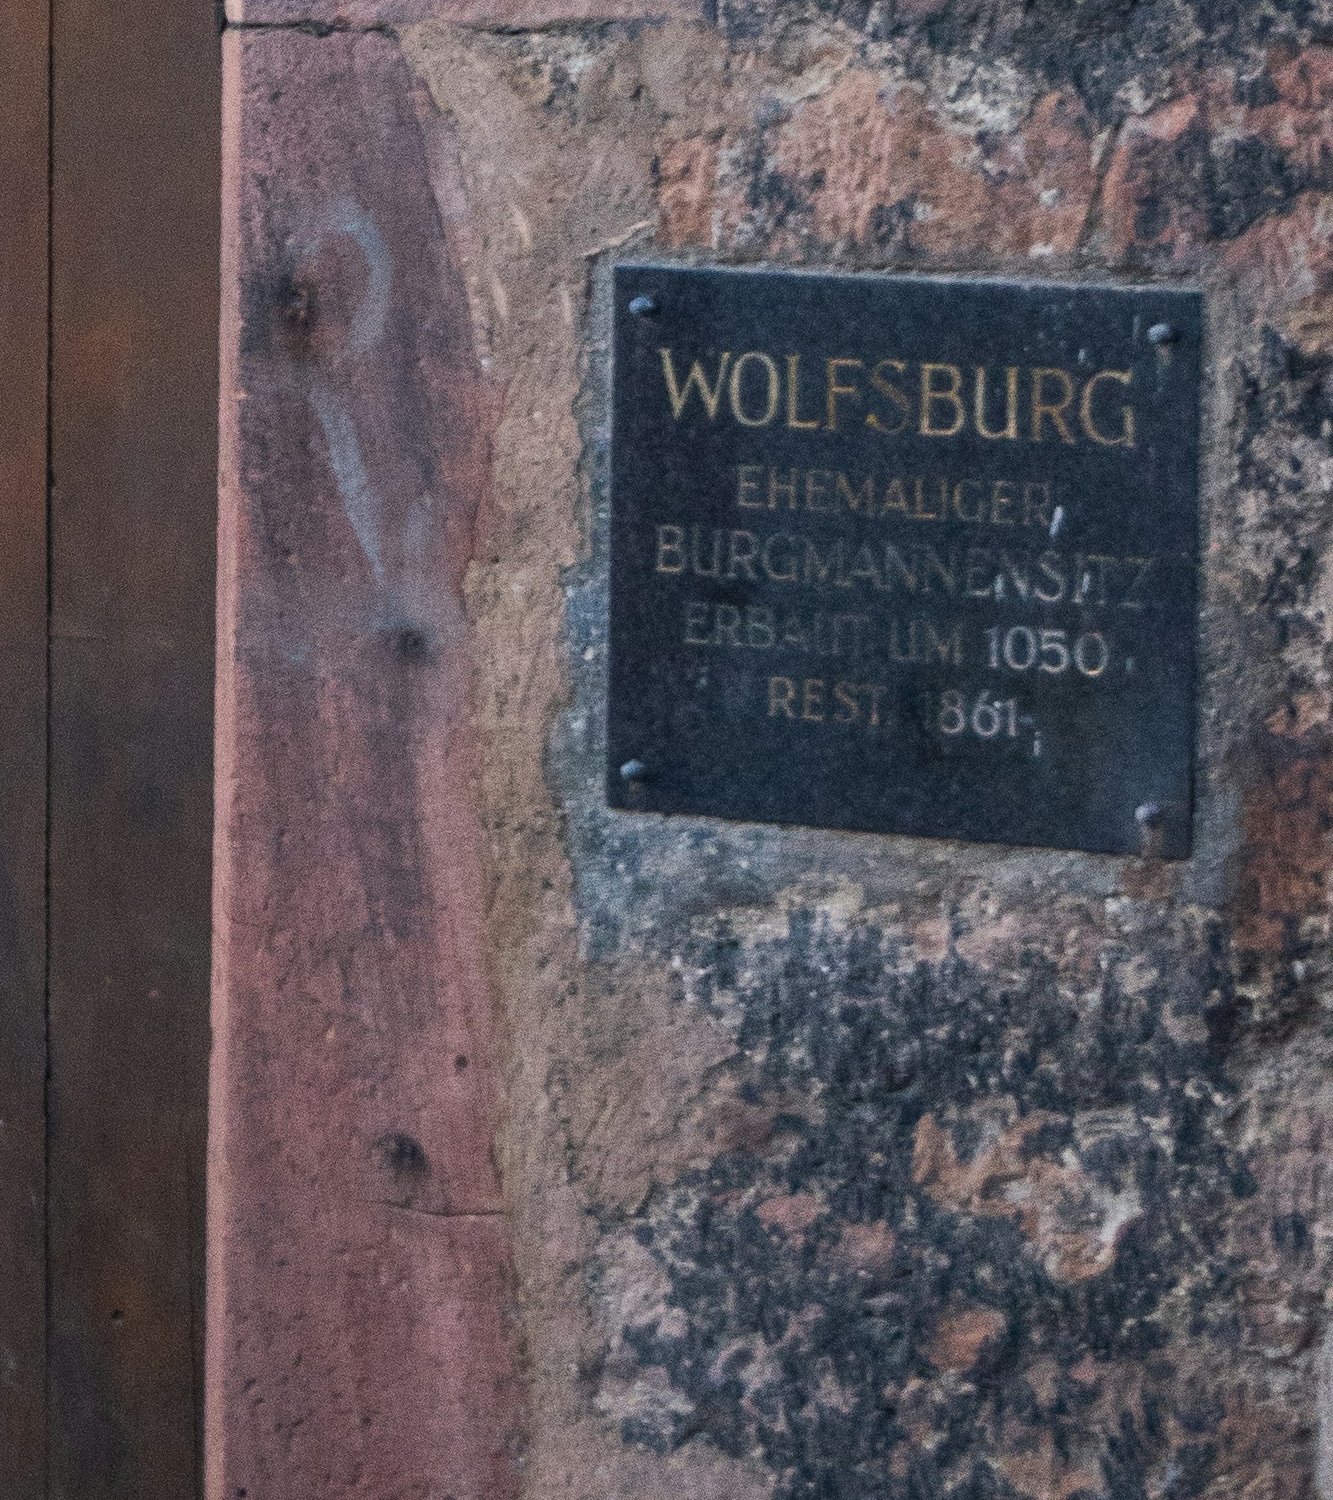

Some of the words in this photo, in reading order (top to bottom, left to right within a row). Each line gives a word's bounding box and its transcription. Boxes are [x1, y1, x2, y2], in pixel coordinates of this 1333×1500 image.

[657, 346, 1137, 449] WOLFSBURG
[735, 464, 1055, 528] EHEMALIGER
[654, 523, 1156, 610] BURGMANNENSITZ
[682, 602, 872, 657] ERBAUT
[889, 615, 965, 666] UM
[985, 625, 1110, 678] 1050
